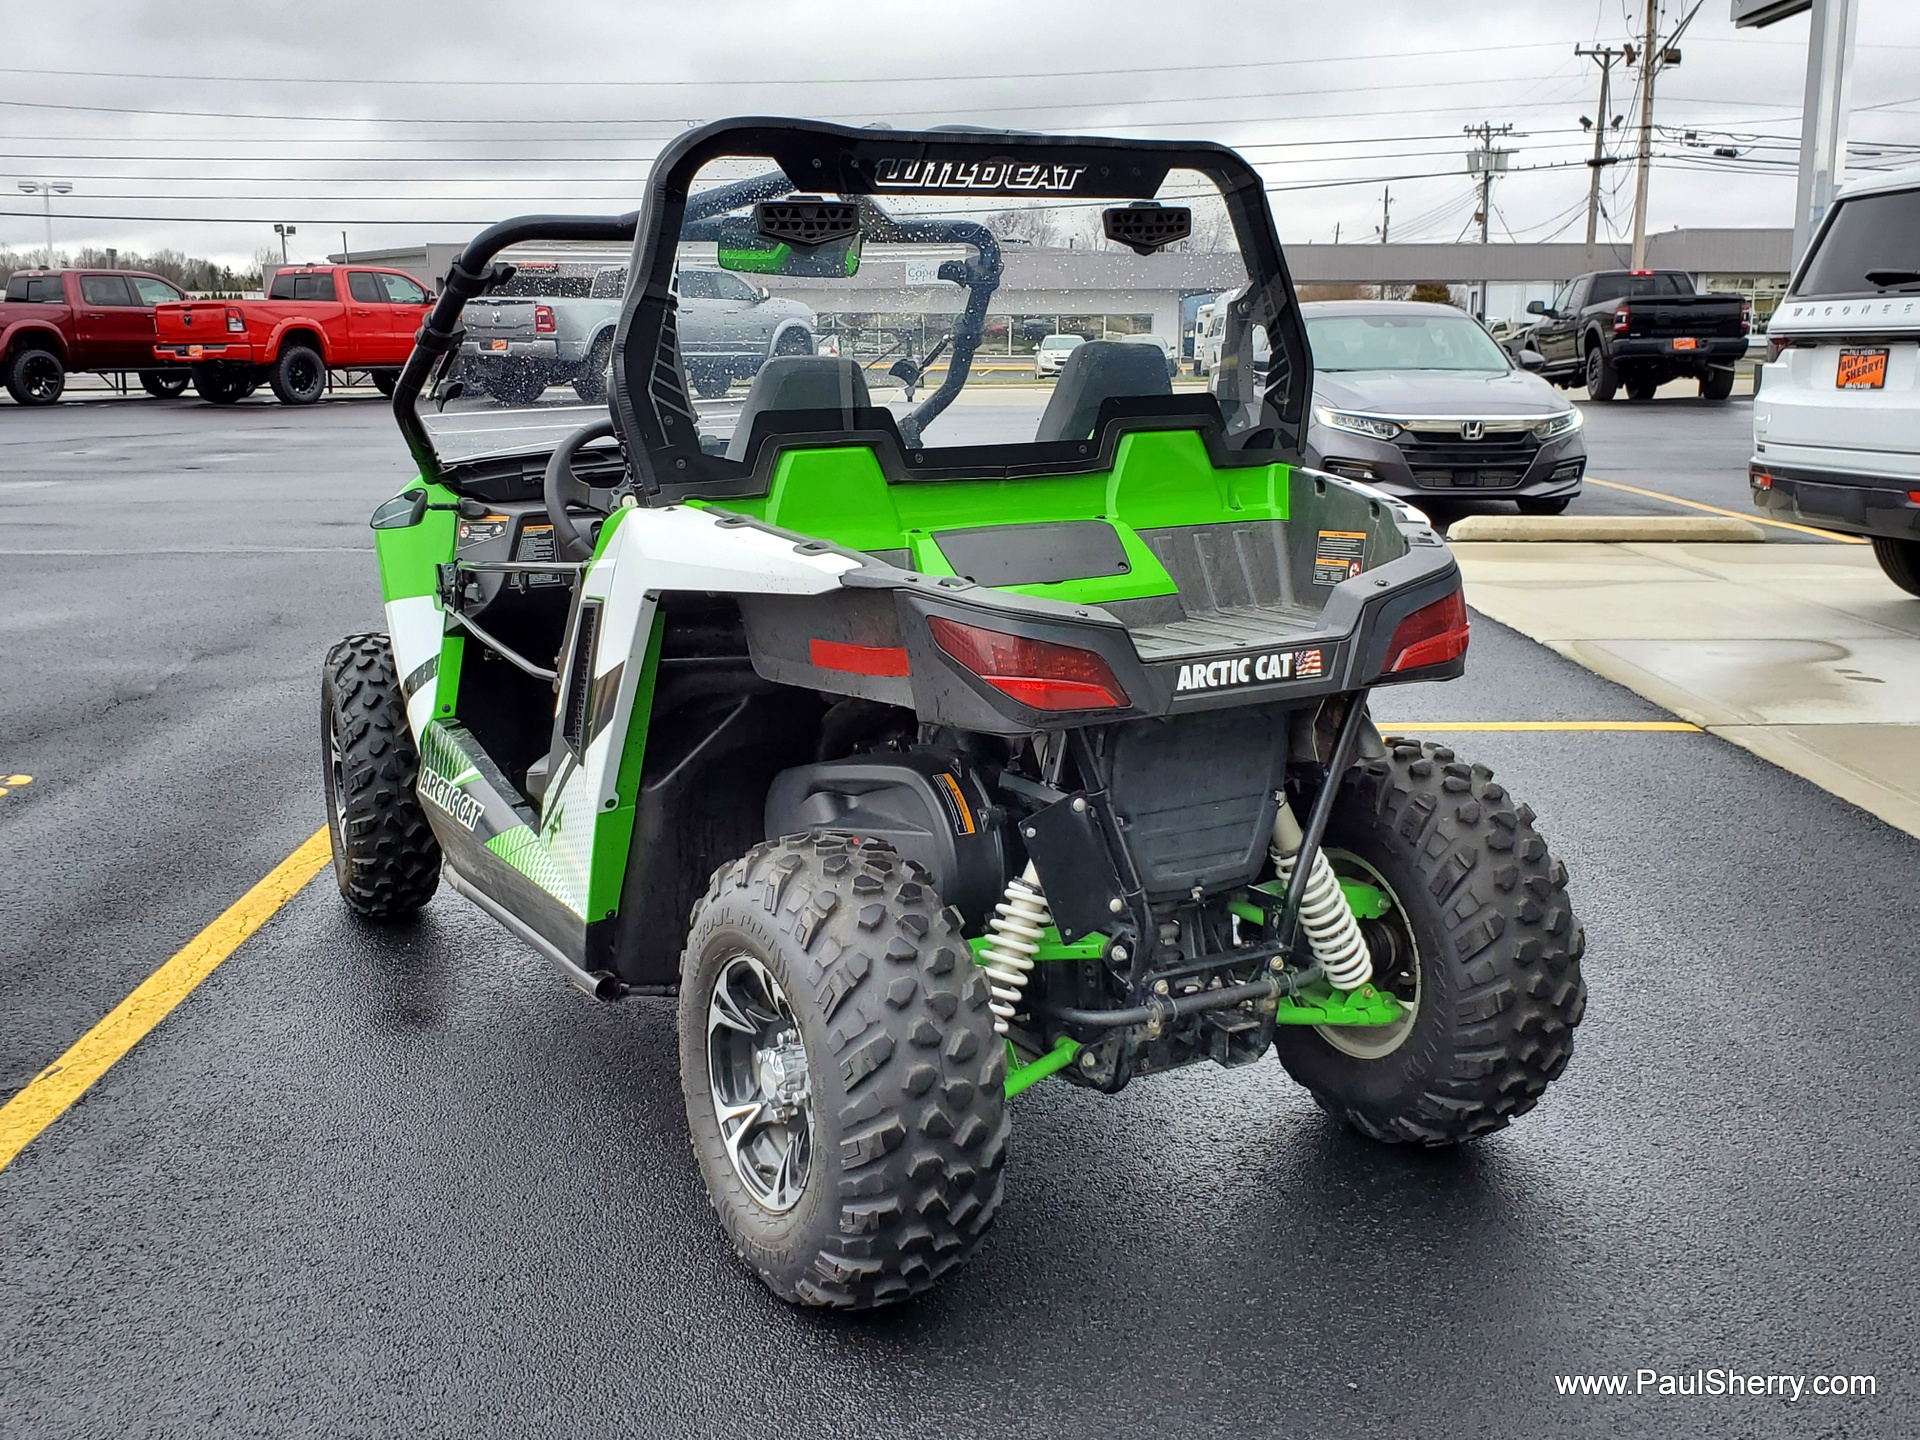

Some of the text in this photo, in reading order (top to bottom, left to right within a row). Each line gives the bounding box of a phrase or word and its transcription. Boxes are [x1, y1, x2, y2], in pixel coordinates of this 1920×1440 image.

[874, 158, 1088, 190] WILDCAT
[1841, 355, 1860, 371] BUY
[1845, 357, 1883, 382] SHERRY!
[1176, 653, 1293, 691] ARCTIC CAT
[418, 767, 485, 832] ARCTIC CAT
